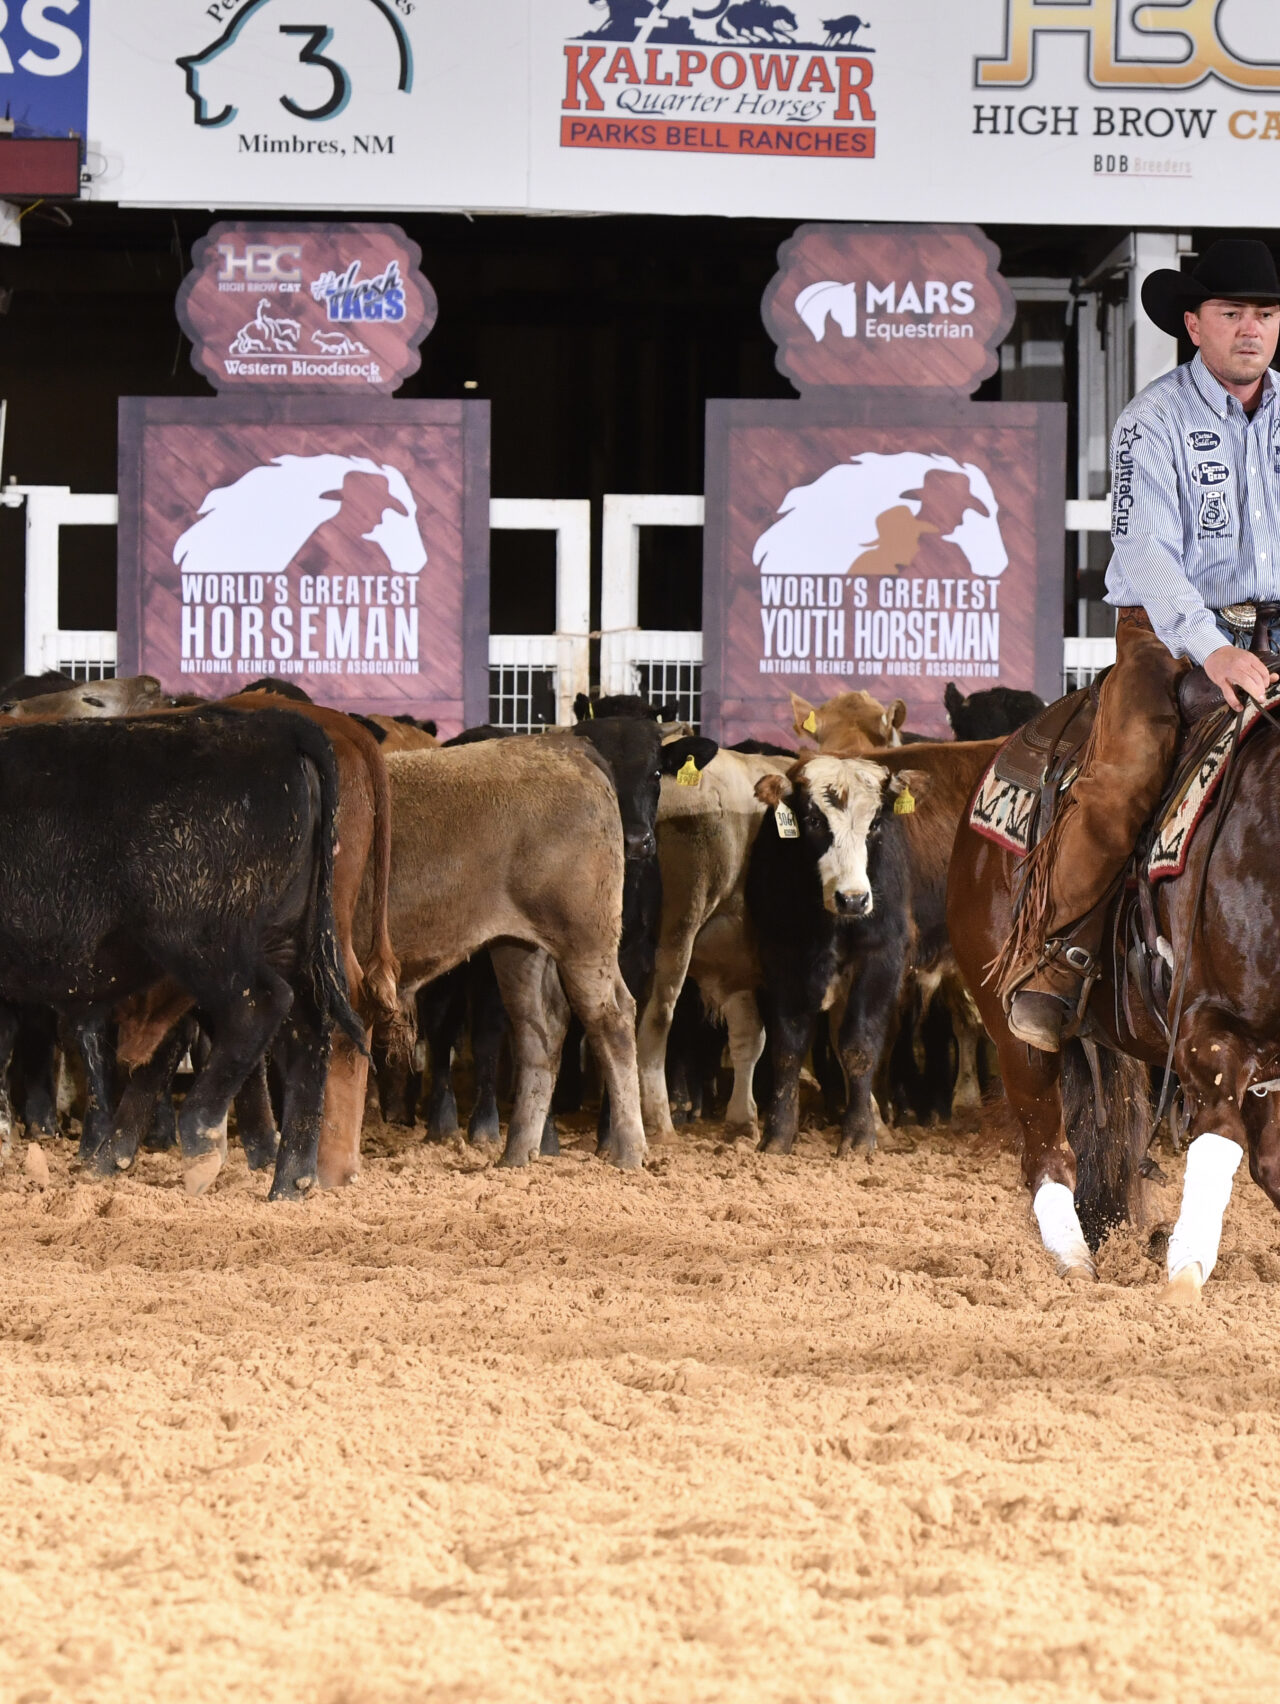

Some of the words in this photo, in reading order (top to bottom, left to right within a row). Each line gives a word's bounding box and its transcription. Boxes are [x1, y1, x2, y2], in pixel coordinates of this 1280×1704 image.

[279, 25, 352, 121] 3
[561, 45, 876, 121] KALPOWAR
[616, 87, 729, 116] Quarter
[733, 92, 827, 123] Horses
[972, 105, 1079, 136] HIGH
[1092, 106, 1218, 139] BROW
[238, 134, 346, 158] Mimbres,
[352, 135, 395, 155] NM
[570, 122, 657, 145] PARKS
[666, 126, 729, 148] BELL
[738, 129, 868, 153] RANCHES
[1093, 154, 1129, 173] BDB
[218, 282, 245, 293] HIGH
[278, 283, 302, 293] CAT
[865, 280, 976, 316] MARS
[326, 287, 406, 323] TAGS
[865, 318, 974, 343] Equestrian
[224, 359, 288, 377] Western
[291, 360, 381, 378] Bloodstock
[1115, 450, 1134, 536] UltraCruz
[181, 574, 289, 605] WORLD'S
[300, 575, 421, 606] GREATEST
[760, 576, 868, 608] WORLD'S
[878, 578, 1001, 611] GREATEST
[181, 605, 420, 660] HORSEMAN
[760, 608, 845, 659] YOUTH
[854, 610, 1000, 661] HORSEMAN
[180, 659, 233, 674] NATIONAL
[237, 660, 276, 674] REINED
[279, 660, 304, 674] COW
[308, 660, 342, 675] HORSE
[346, 660, 420, 675] ASSOCIATION
[759, 659, 812, 675] NATIONAL
[816, 660, 854, 676] REINED
[858, 661, 883, 676] COW
[887, 662, 922, 677] HORSE
[926, 662, 1000, 678] ASSOCIATION
